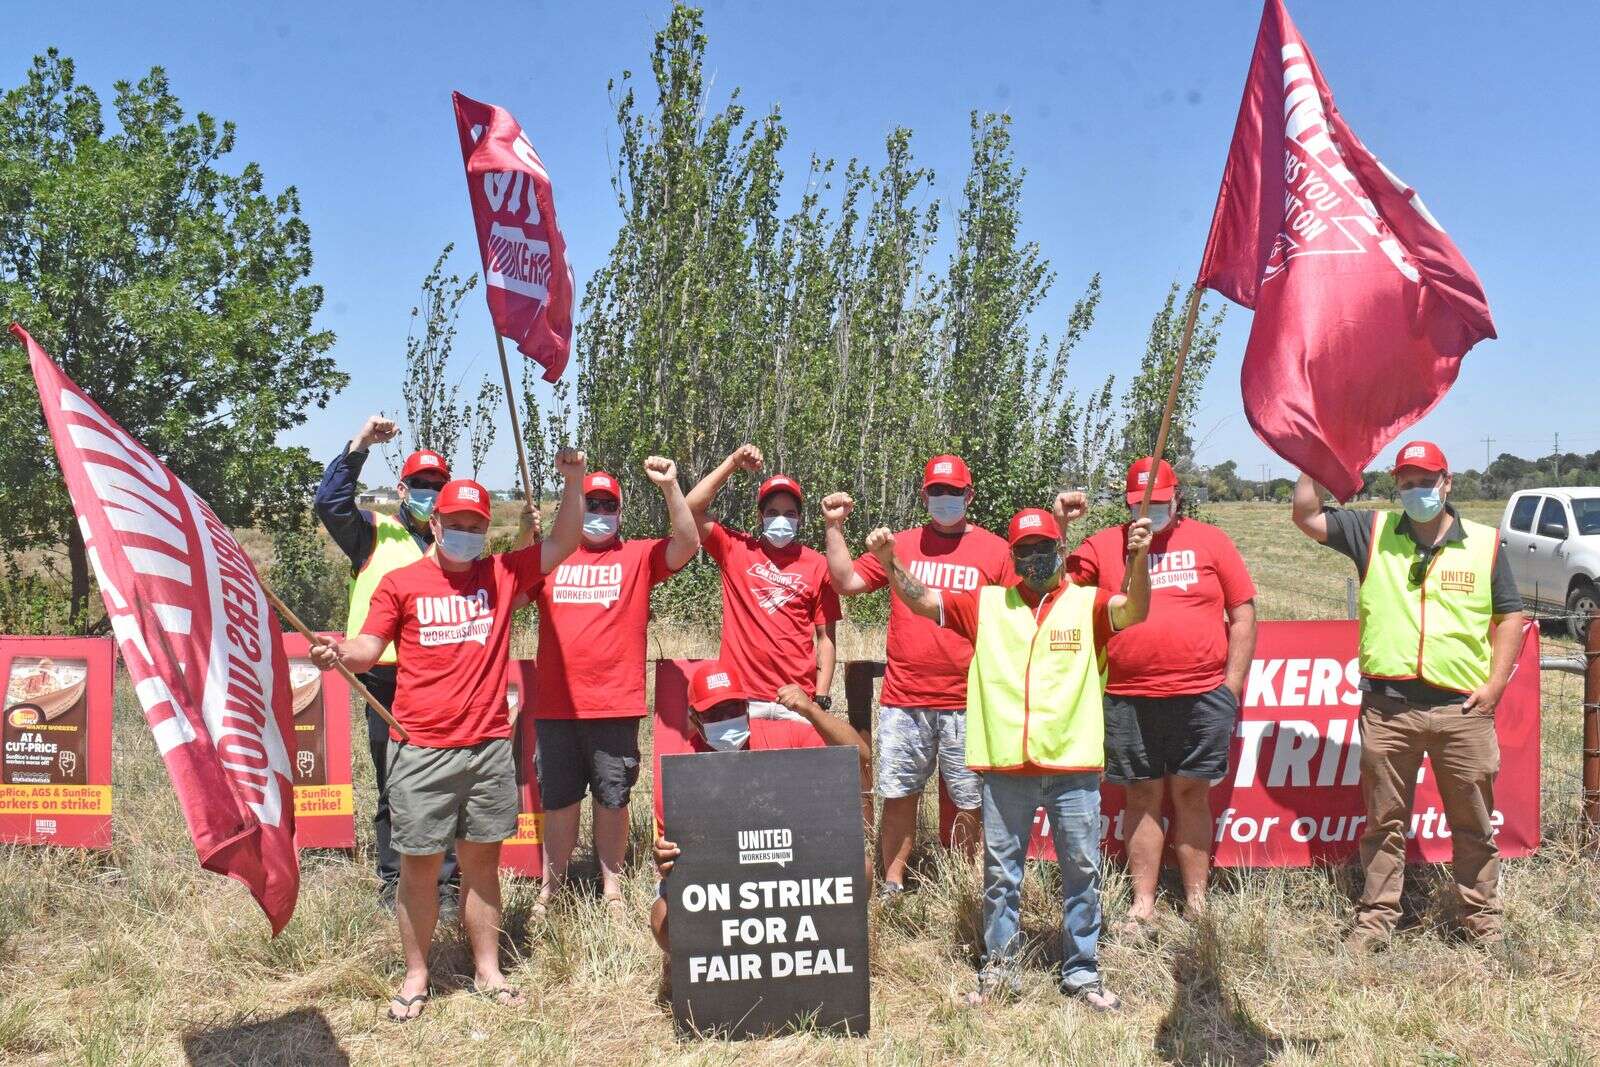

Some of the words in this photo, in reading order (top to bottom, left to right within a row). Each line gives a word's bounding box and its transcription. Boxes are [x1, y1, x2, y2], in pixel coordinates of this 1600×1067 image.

[1297, 170, 1341, 211] YOU
[1292, 209, 1328, 242] ON
[555, 563, 622, 586] UNITED
[909, 560, 979, 591] UNITED
[1441, 570, 1475, 583] UNITED
[555, 589, 592, 600] WORKERS
[594, 588, 618, 600] UNION
[416, 588, 490, 625] UNITED
[423, 626, 467, 642] WORKERS
[1050, 629, 1081, 641] UNITED
[20, 732, 34, 743] AT
[35, 733, 43, 743] A
[5, 742, 58, 754] CUT-PRICE
[31, 787, 51, 798] AGS
[53, 788, 61, 798] &
[62, 788, 102, 799] SunRice
[301, 789, 342, 799] SunRice
[42, 801, 58, 810] on
[61, 799, 102, 811] strike!
[300, 798, 342, 812] strike!
[1215, 808, 1279, 842] for
[1290, 815, 1366, 843] our
[738, 829, 792, 849] UNITED
[742, 853, 771, 861] WORKERS
[772, 852, 791, 860] UNION
[682, 884, 731, 912] ON
[739, 876, 853, 910] STRIKE
[722, 917, 787, 946] FOR
[795, 915, 819, 942] A
[690, 954, 762, 983] FAIR
[771, 948, 853, 978] DEAL
